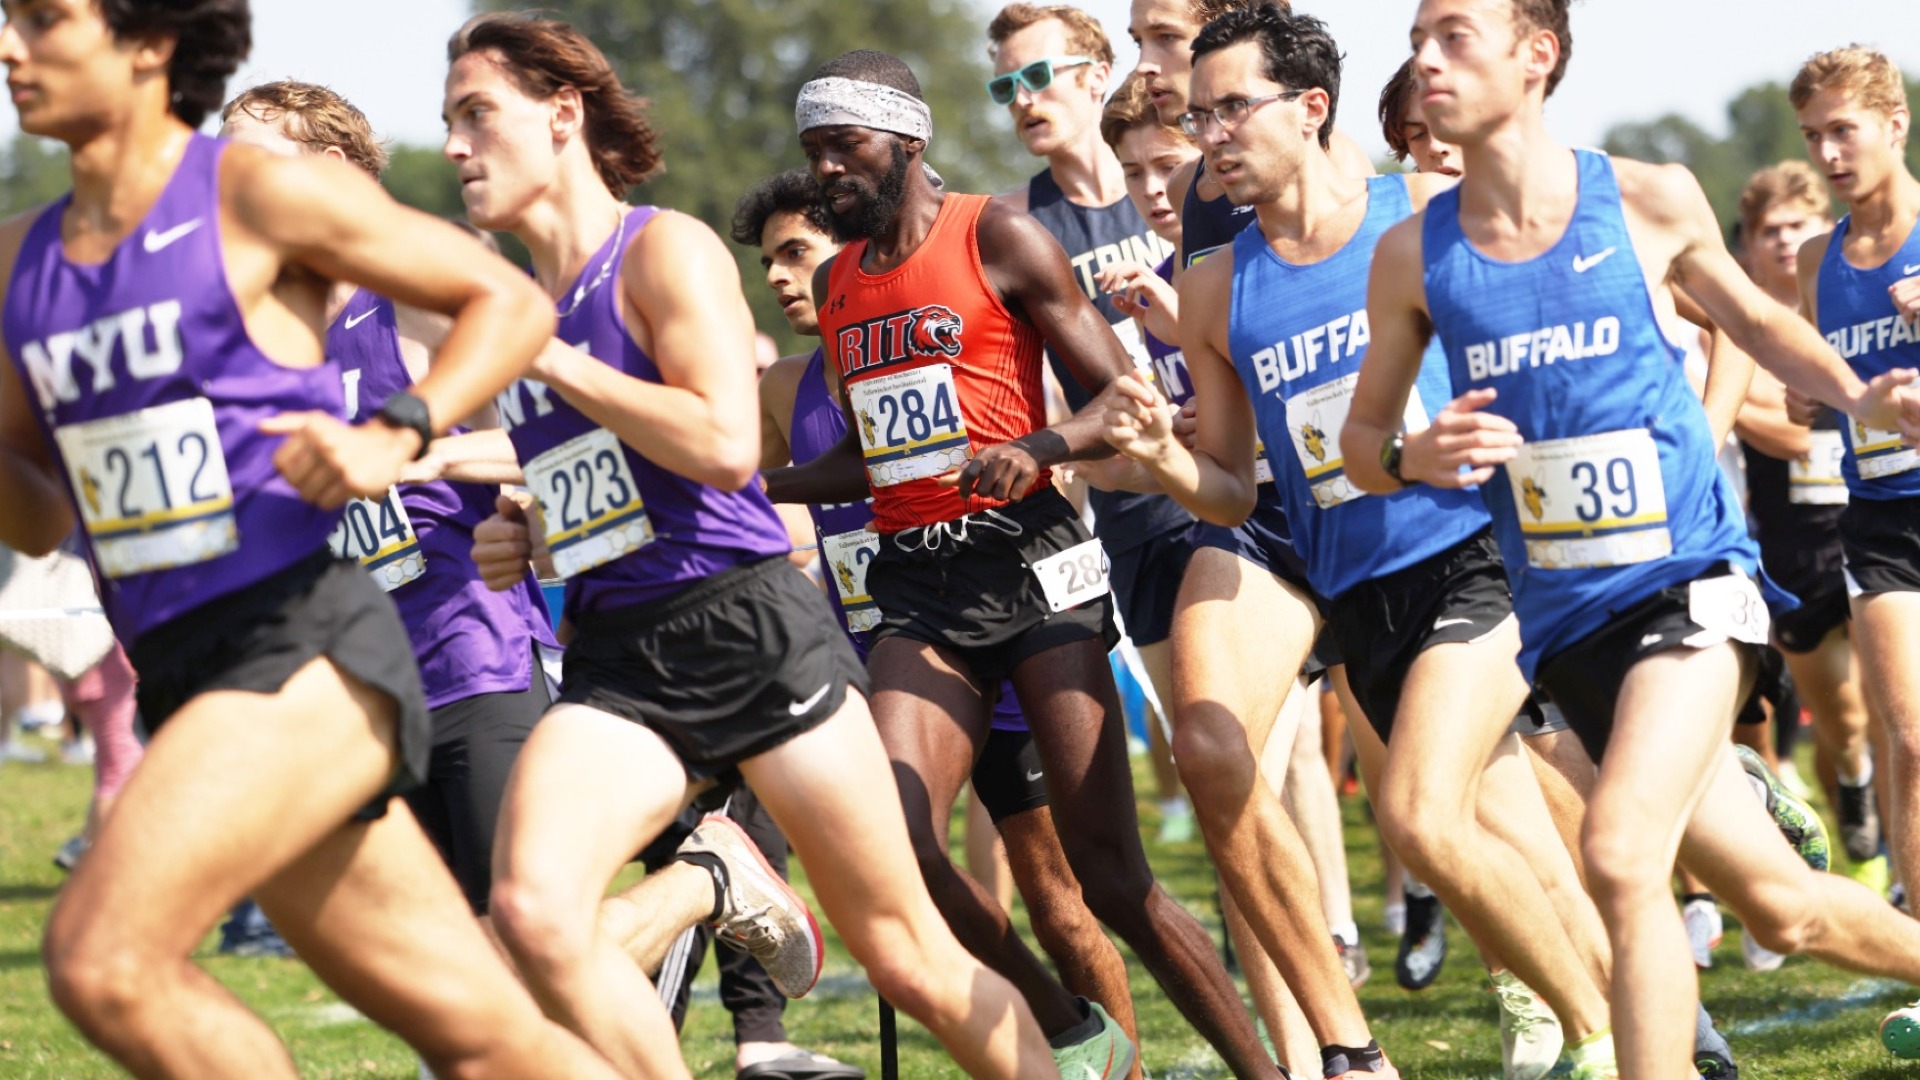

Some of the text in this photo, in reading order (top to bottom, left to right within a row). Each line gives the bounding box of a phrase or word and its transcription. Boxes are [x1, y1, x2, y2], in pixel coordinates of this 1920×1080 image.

[21, 299, 184, 410] NYU
[837, 312, 912, 377] RIT
[1465, 316, 1621, 381] BUFFALO
[878, 382, 960, 447] 284
[104, 431, 219, 519] 212
[551, 448, 632, 532] 223
[1571, 456, 1640, 523] 39
